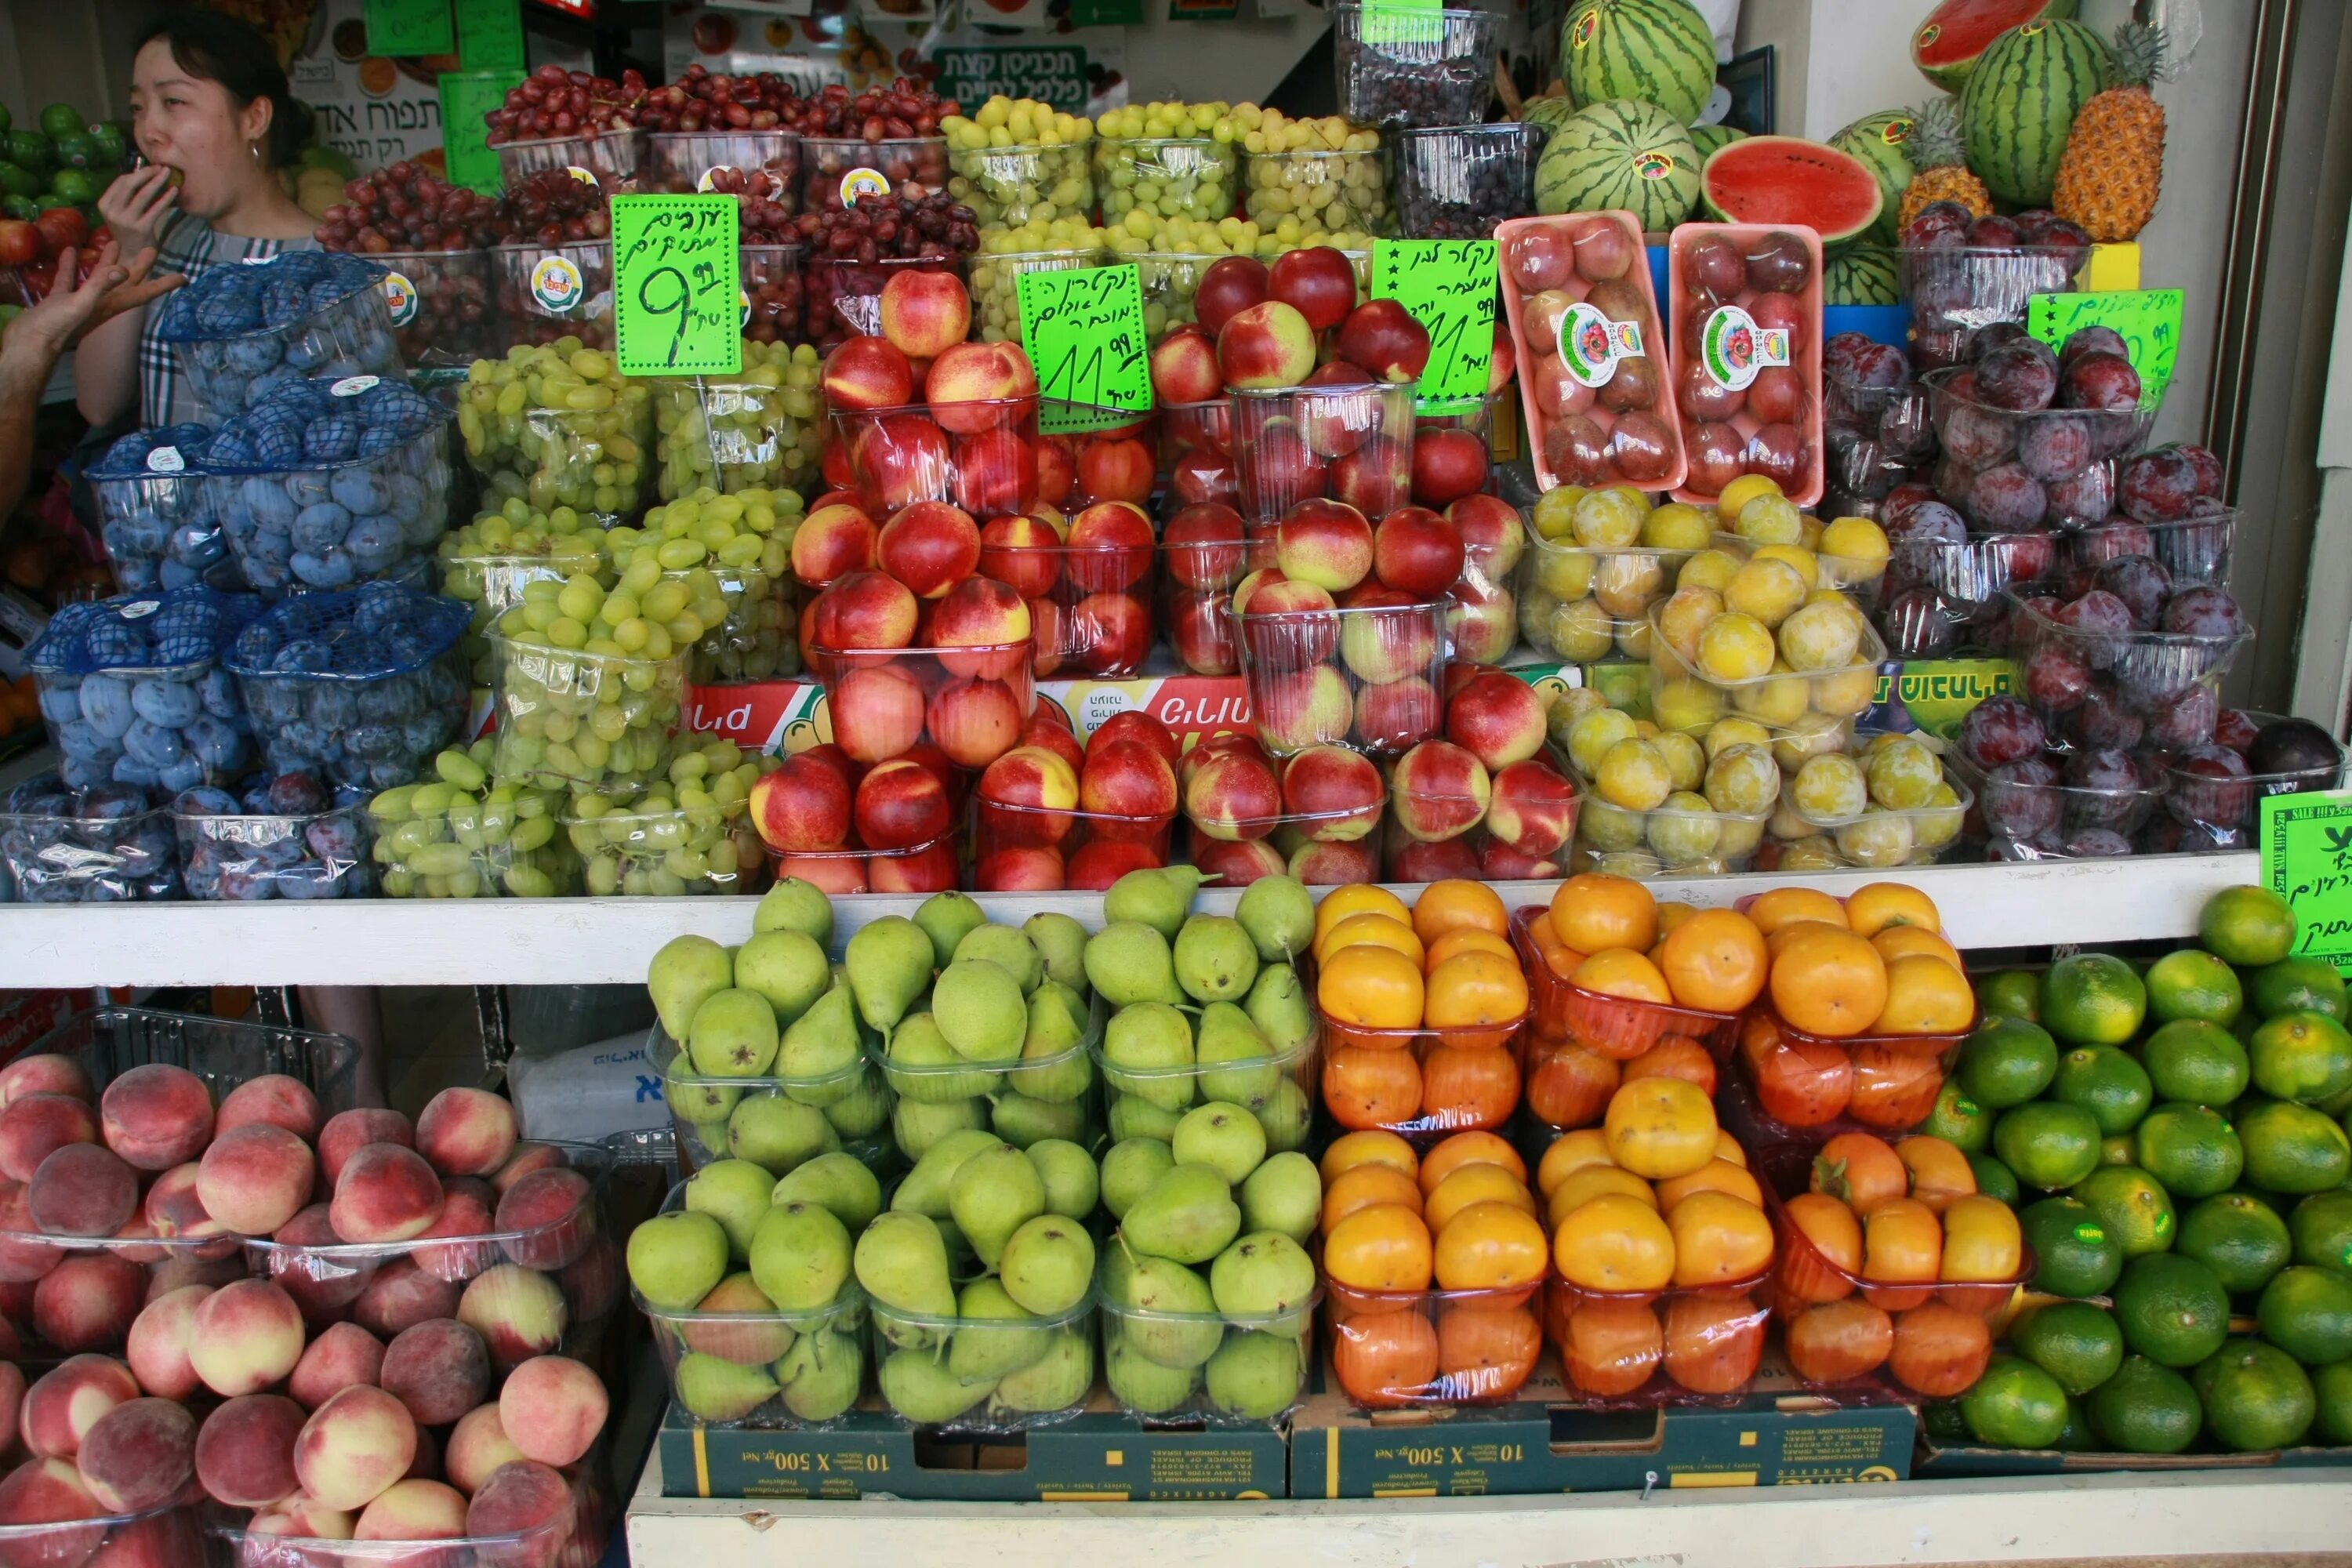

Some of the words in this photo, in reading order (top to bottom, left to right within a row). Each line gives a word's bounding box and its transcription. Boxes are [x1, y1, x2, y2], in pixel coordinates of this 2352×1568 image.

[944, 53, 996, 79] קצת
[1022, 78, 1081, 102] פלפל
[367, 100, 442, 130] תפוח
[376, 138, 405, 162] רק
[1410, 243, 1443, 270] לבן
[1899, 673, 2009, 702] מובחרים
[1090, 695, 1122, 704] העונה
[2292, 807, 2314, 820] SALE
[2274, 849, 2285, 871] SALE
[2079, 1229, 2103, 1239] Jaffa
[742, 1453, 760, 1462] Net
[1375, 1449, 1393, 1458] Net
[1451, 1446, 1464, 1463] X
[1501, 1444, 1523, 1461] 10
[817, 1454, 830, 1471] X
[866, 1454, 890, 1472] 10
